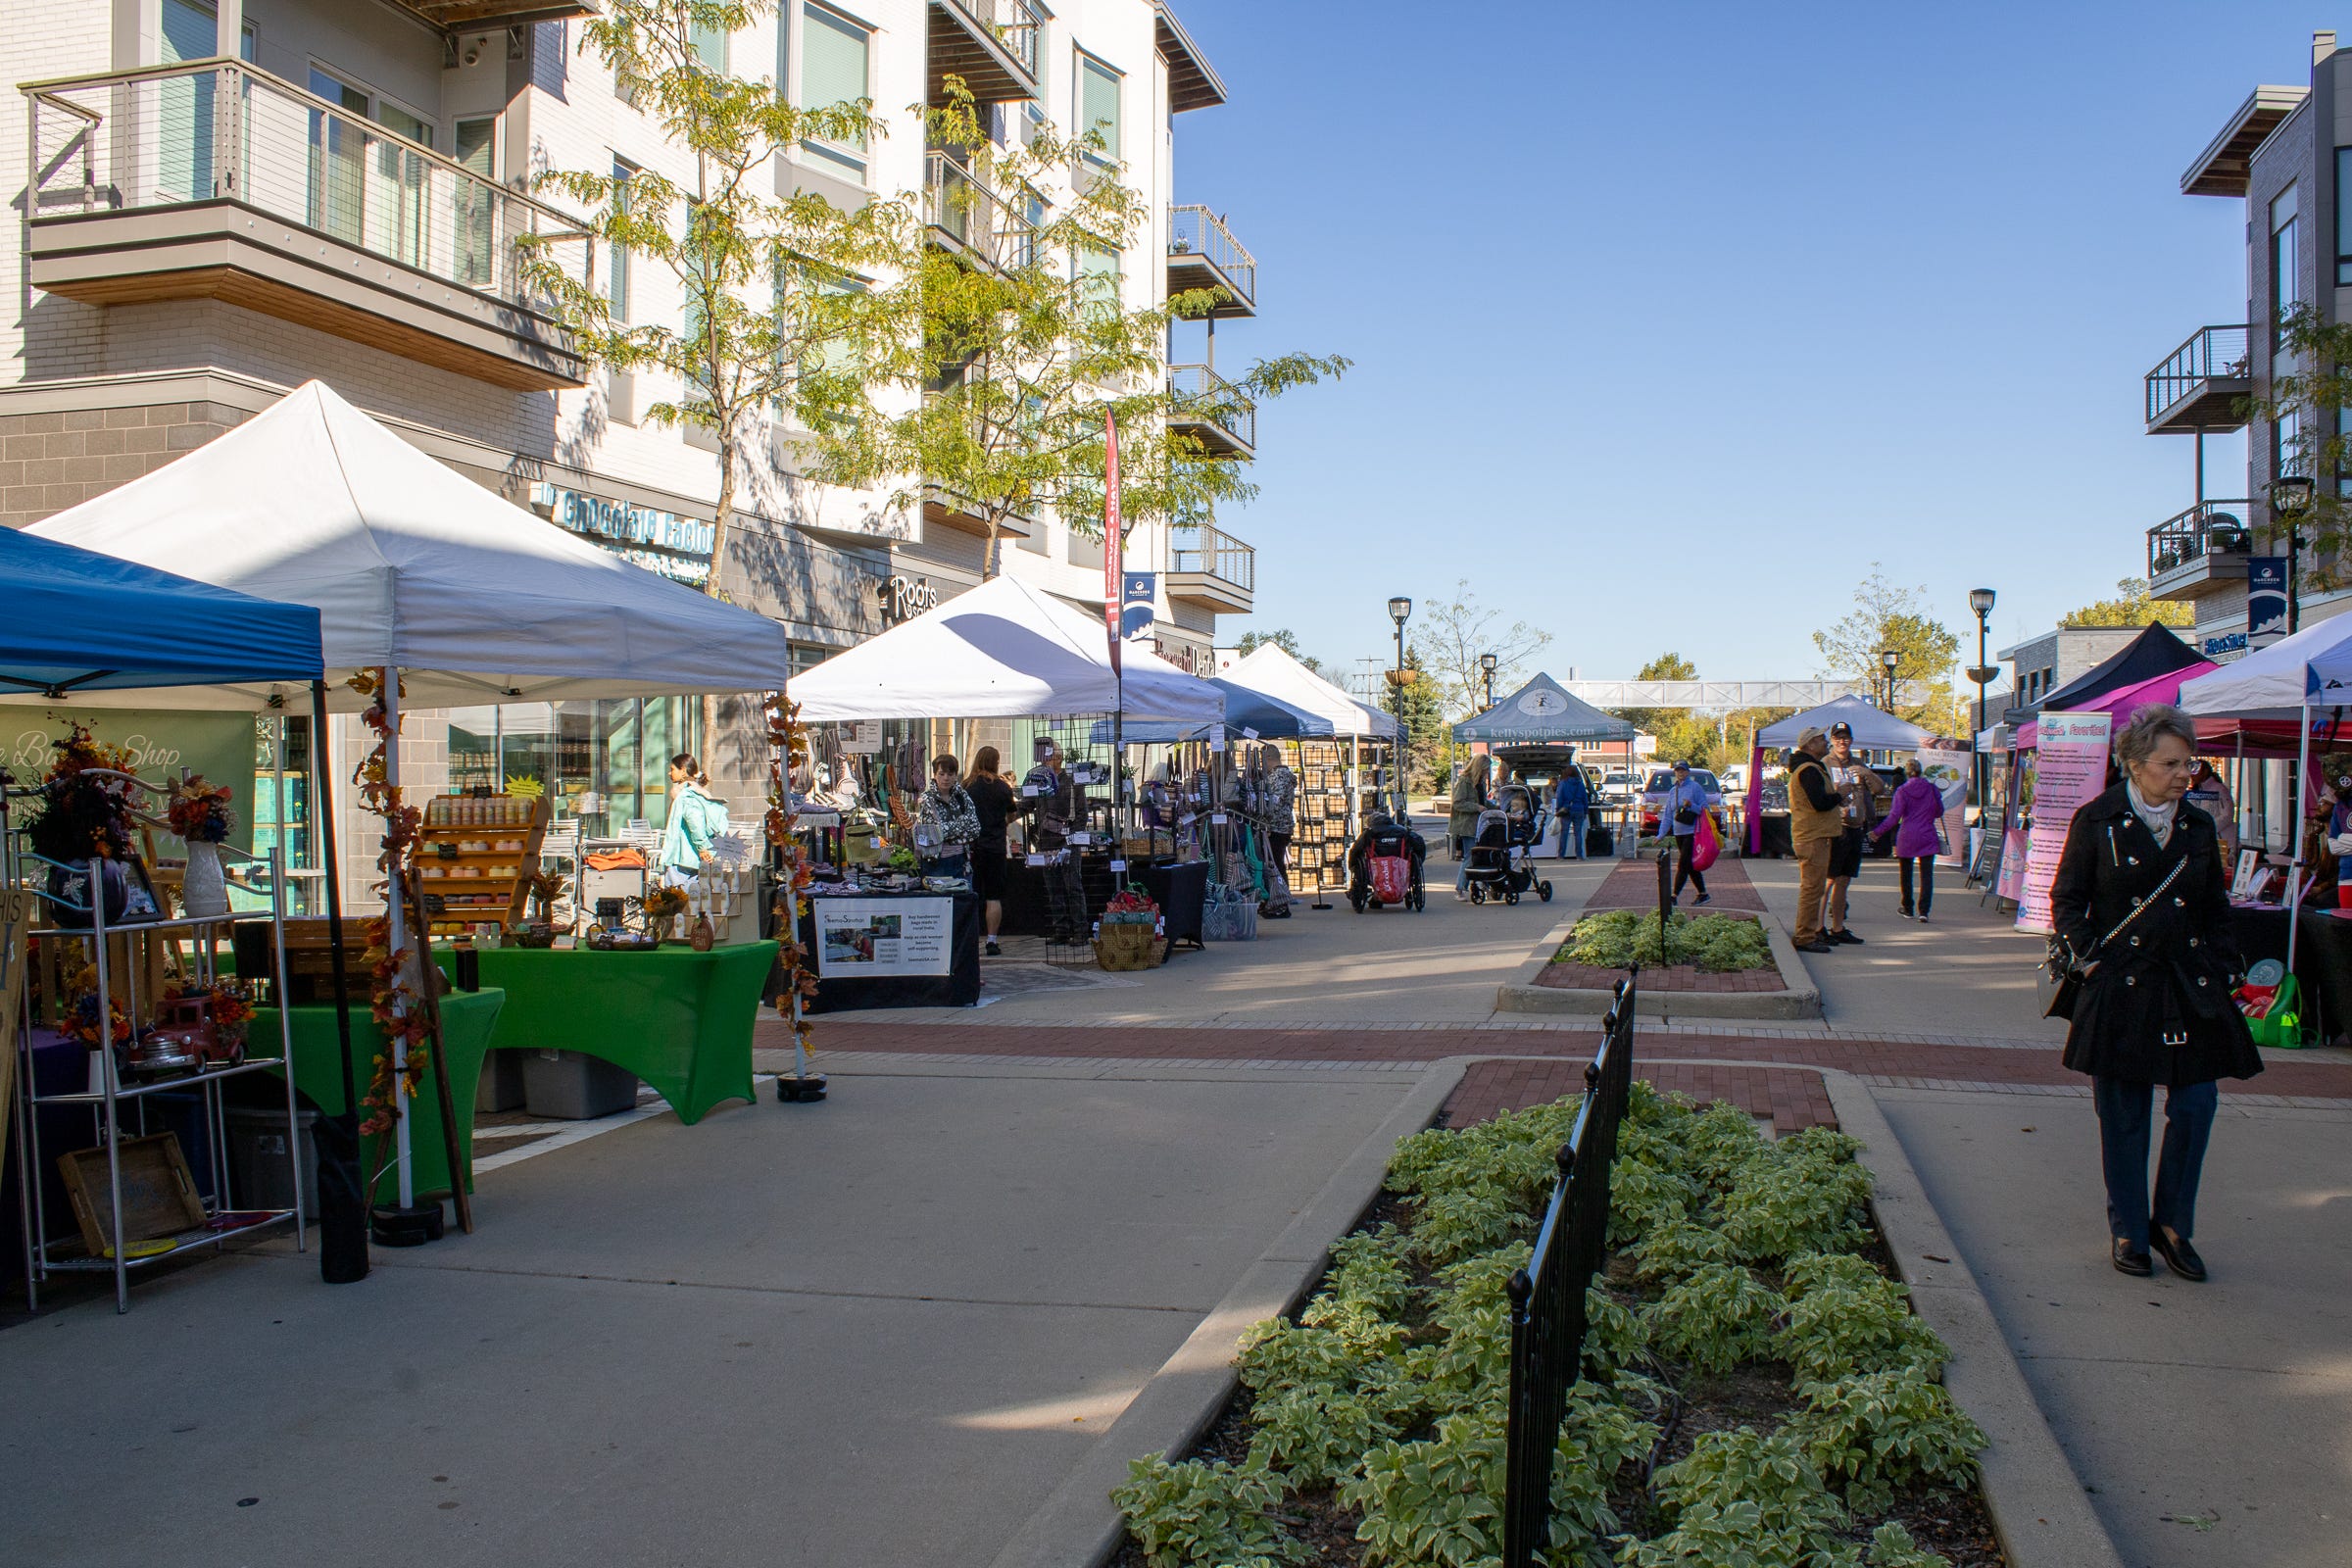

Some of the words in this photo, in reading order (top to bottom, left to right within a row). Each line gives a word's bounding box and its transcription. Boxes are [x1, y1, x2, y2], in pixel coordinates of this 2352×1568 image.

[562, 490, 658, 541] Chocolate
[663, 512, 718, 556] Factor
[890, 575, 937, 619] Roots
[1491, 725, 1594, 741] kellyspotpies.com
[124, 735, 180, 774] Shop
